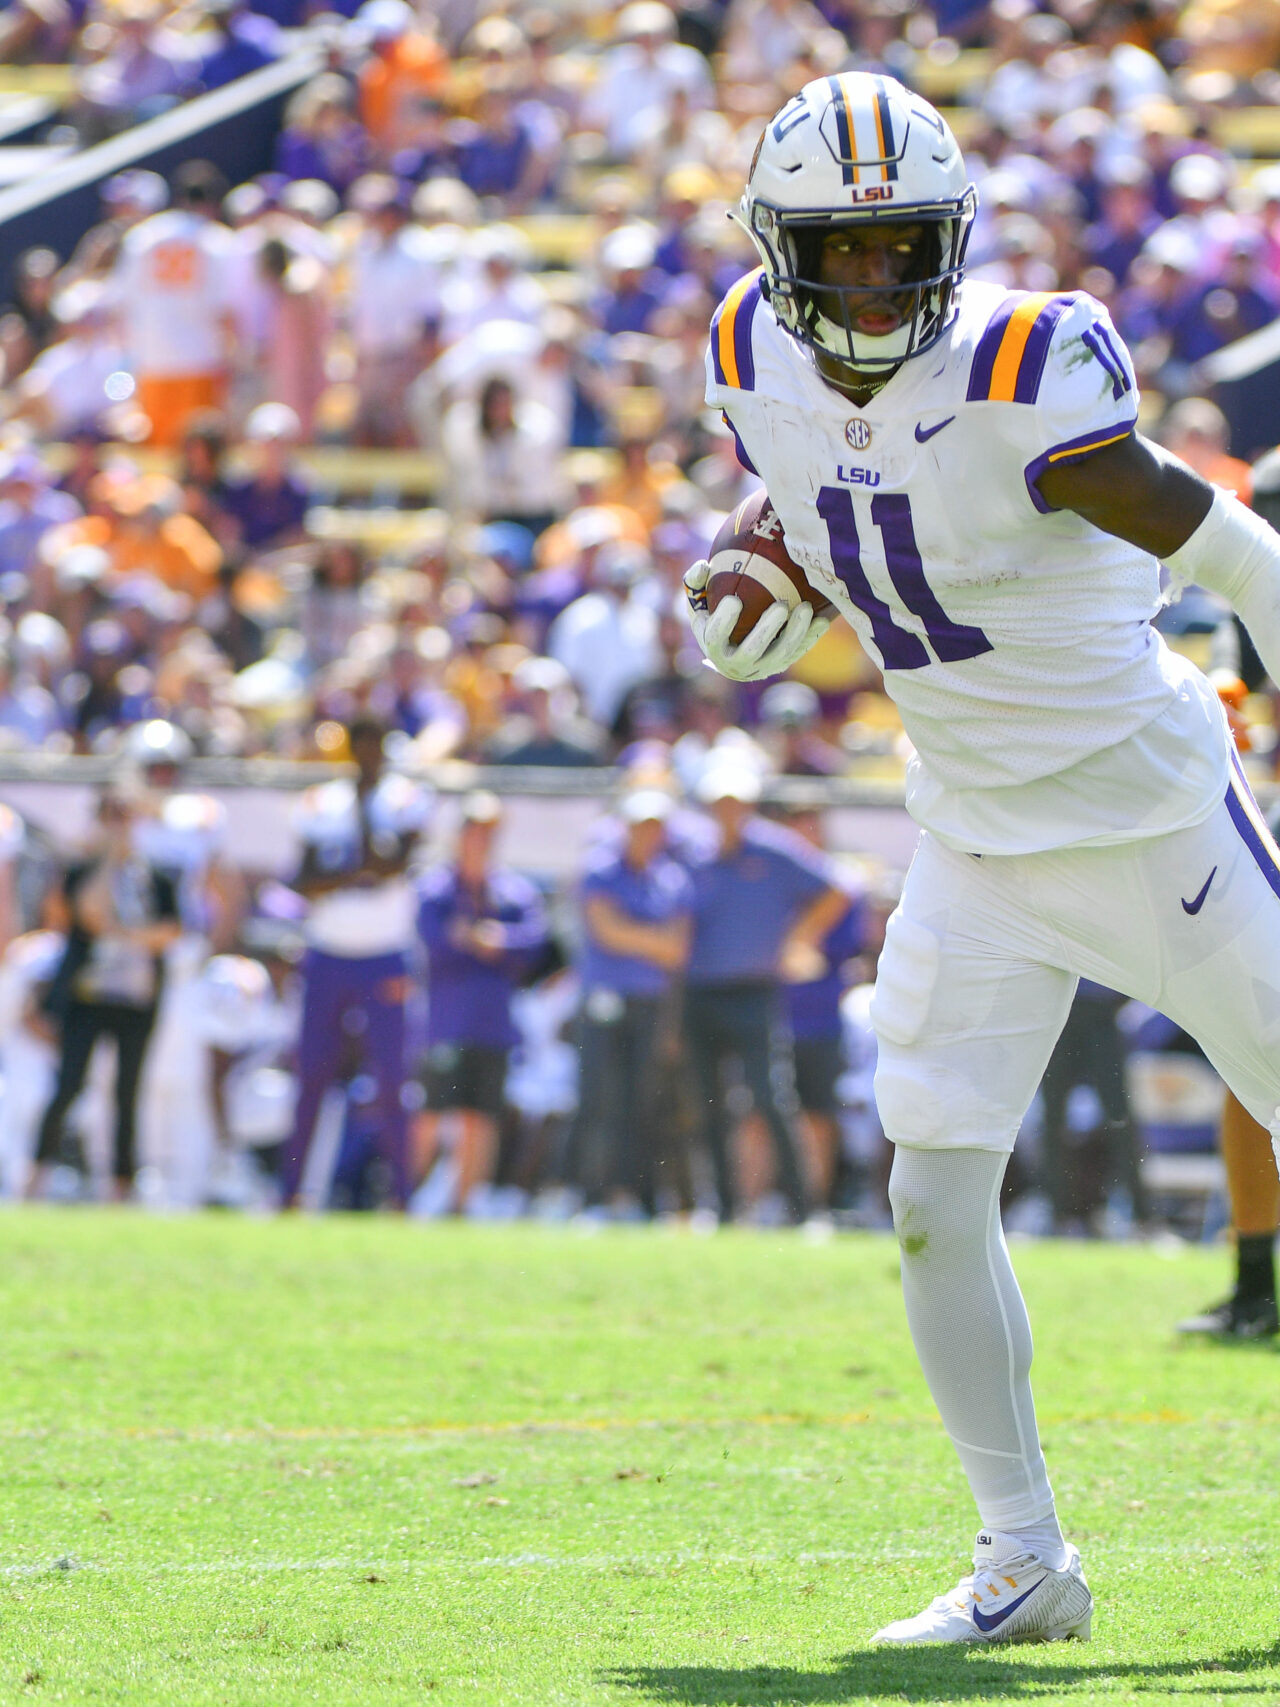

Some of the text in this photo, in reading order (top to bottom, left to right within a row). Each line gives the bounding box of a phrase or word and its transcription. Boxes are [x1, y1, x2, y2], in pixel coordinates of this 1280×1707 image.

[851, 185, 894, 203] LSU
[1081, 320, 1132, 402] 11
[846, 417, 872, 450] SEC
[837, 464, 881, 487] LSU
[816, 485, 995, 670] 11
[976, 1535, 992, 1546] LSU
